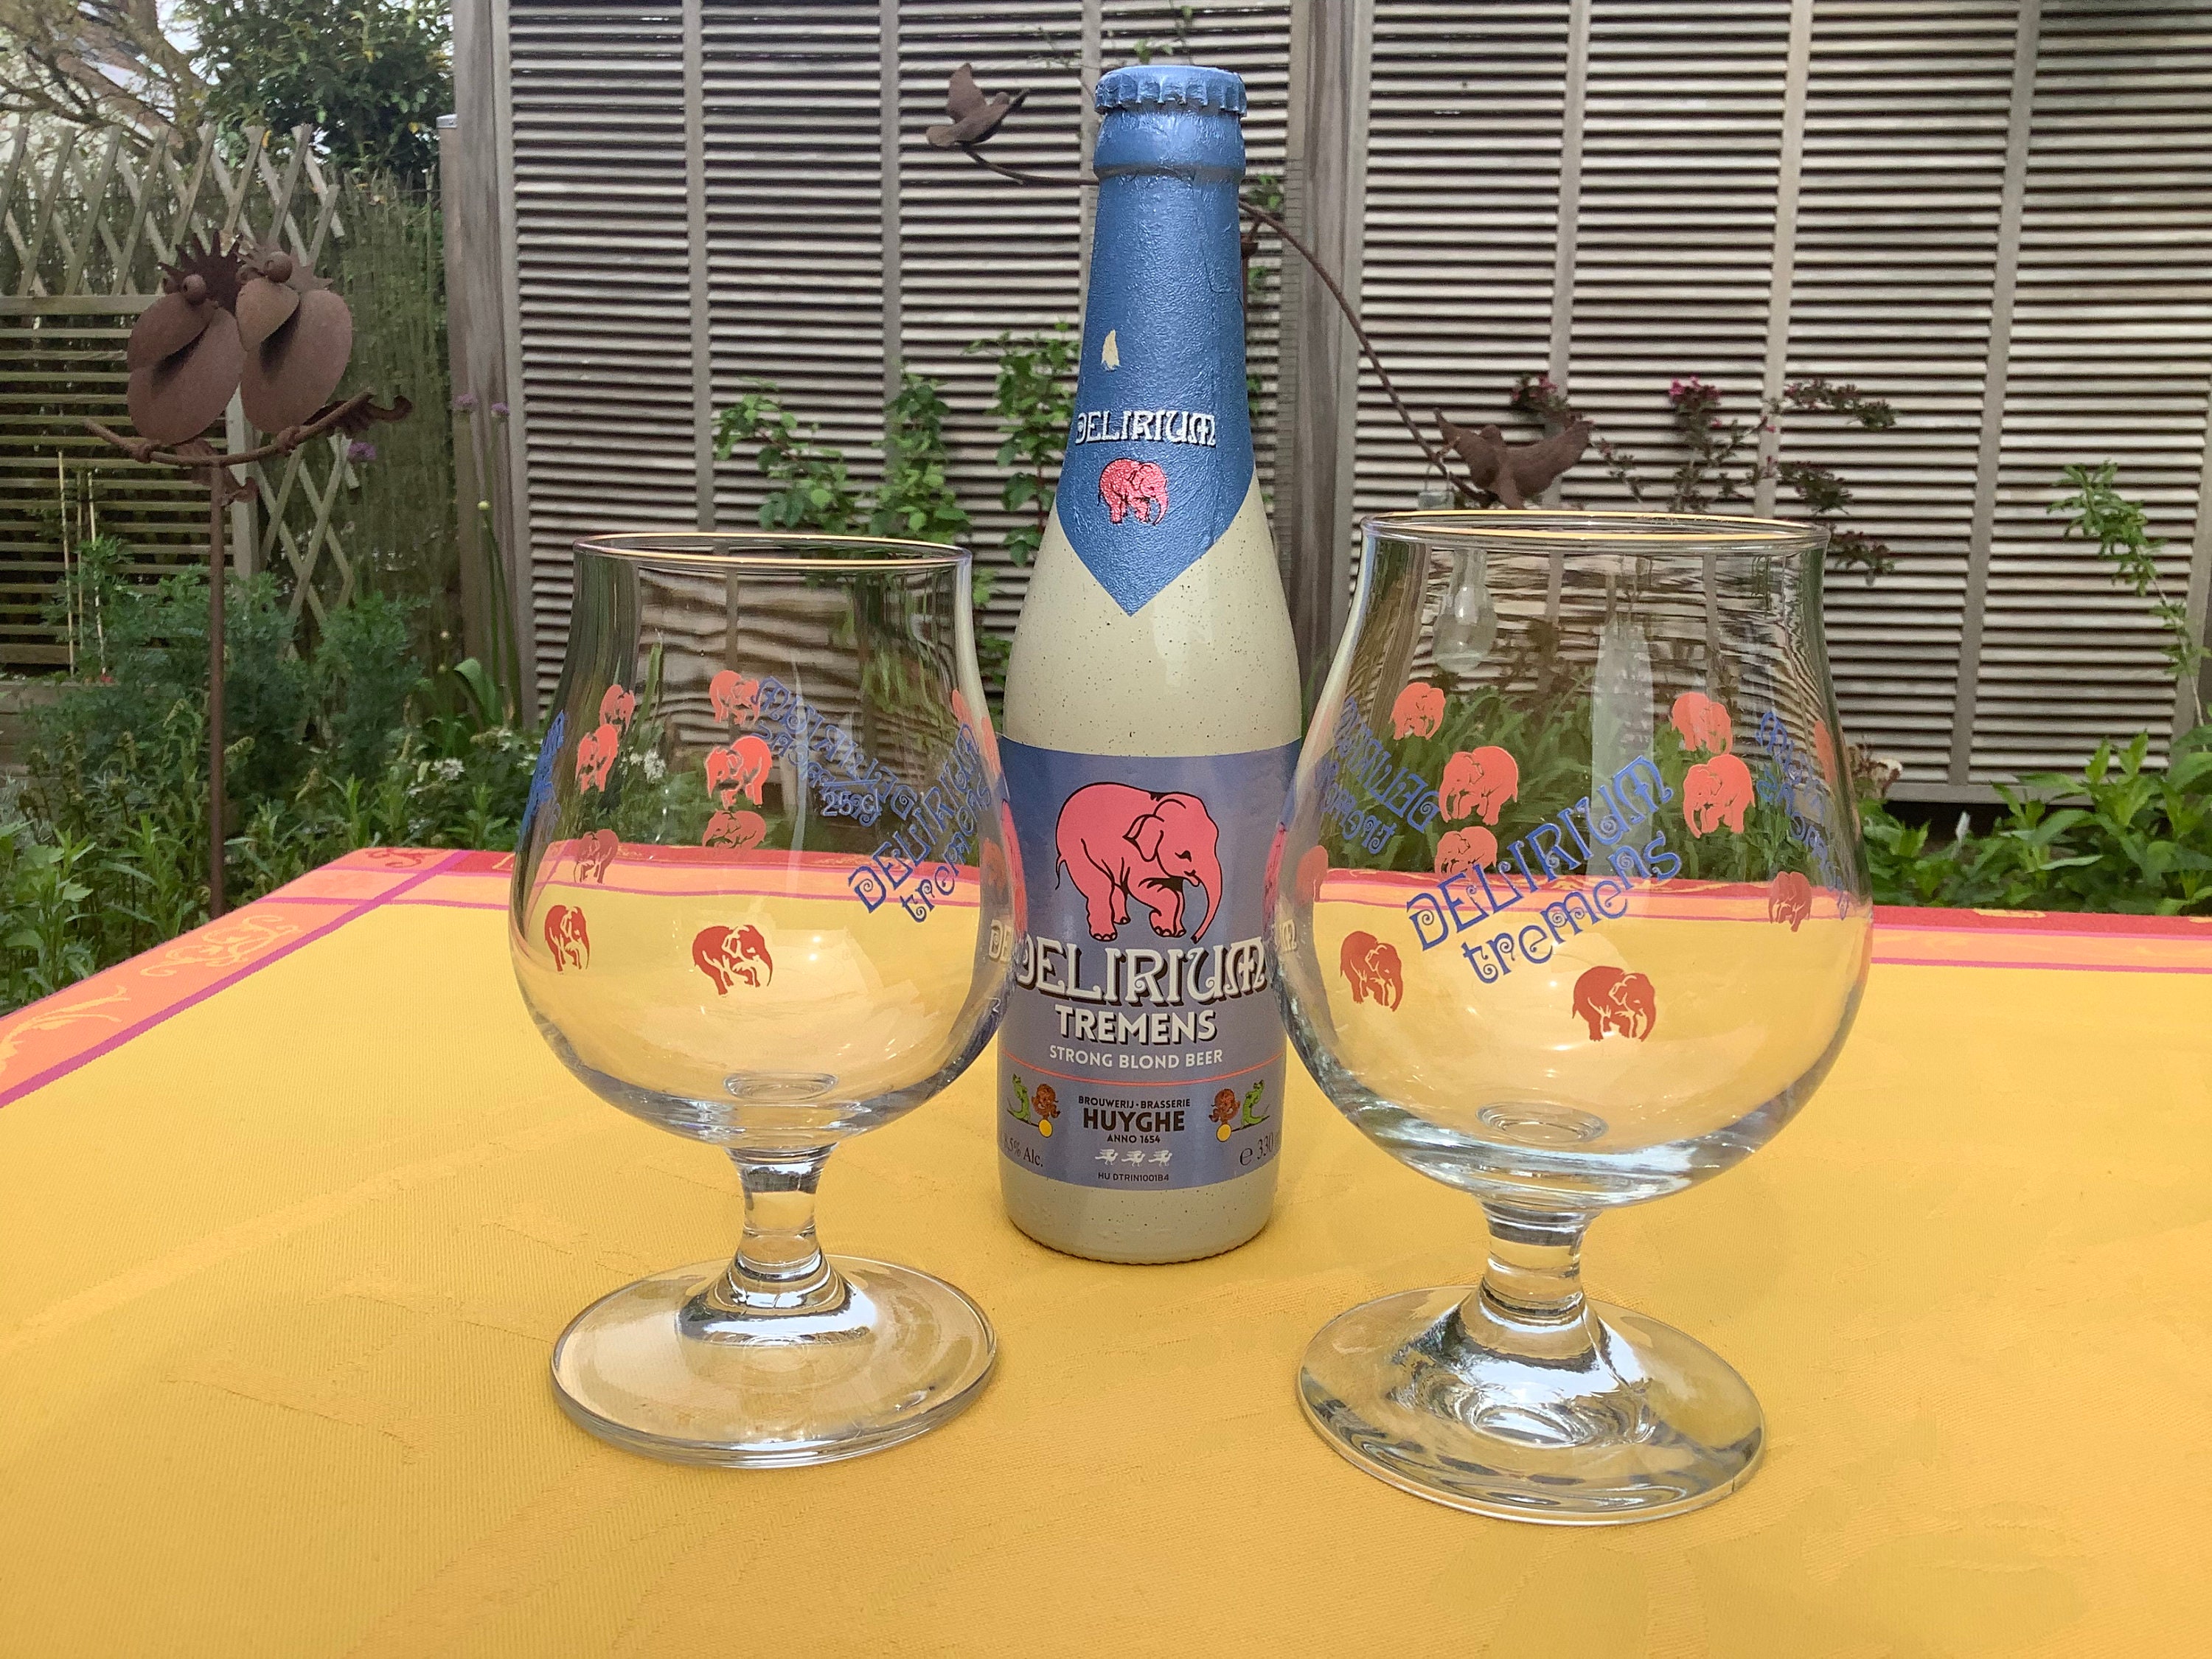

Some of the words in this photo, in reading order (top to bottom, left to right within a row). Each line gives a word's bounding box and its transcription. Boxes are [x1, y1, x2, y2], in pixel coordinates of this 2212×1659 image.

[1076, 410, 1217, 447] DELIRIUM
[848, 723, 980, 914] DELIRIUM
[1407, 755, 1673, 951] DELIRIUM
[1461, 830, 1683, 984] tremens
[1015, 933, 1267, 1005] DELIRIUM
[1054, 1004, 1218, 1046] TREMENS
[1049, 1044, 1113, 1068] STRONG
[1119, 1054, 1180, 1069] BLOND
[1186, 1048, 1223, 1068] BEER
[1078, 1095, 1134, 1109] BROUWERIJ
[1140, 1098, 1191, 1109] BRASSERIE
[1083, 1107, 1185, 1133] HUYGHE
[1107, 1134, 1137, 1143] ANNO
[1140, 1135, 1161, 1144] 1654
[1256, 1132, 1274, 1160] 330
[1023, 1147, 1043, 1167] Alc.
[1098, 1172, 1110, 1180] HU
